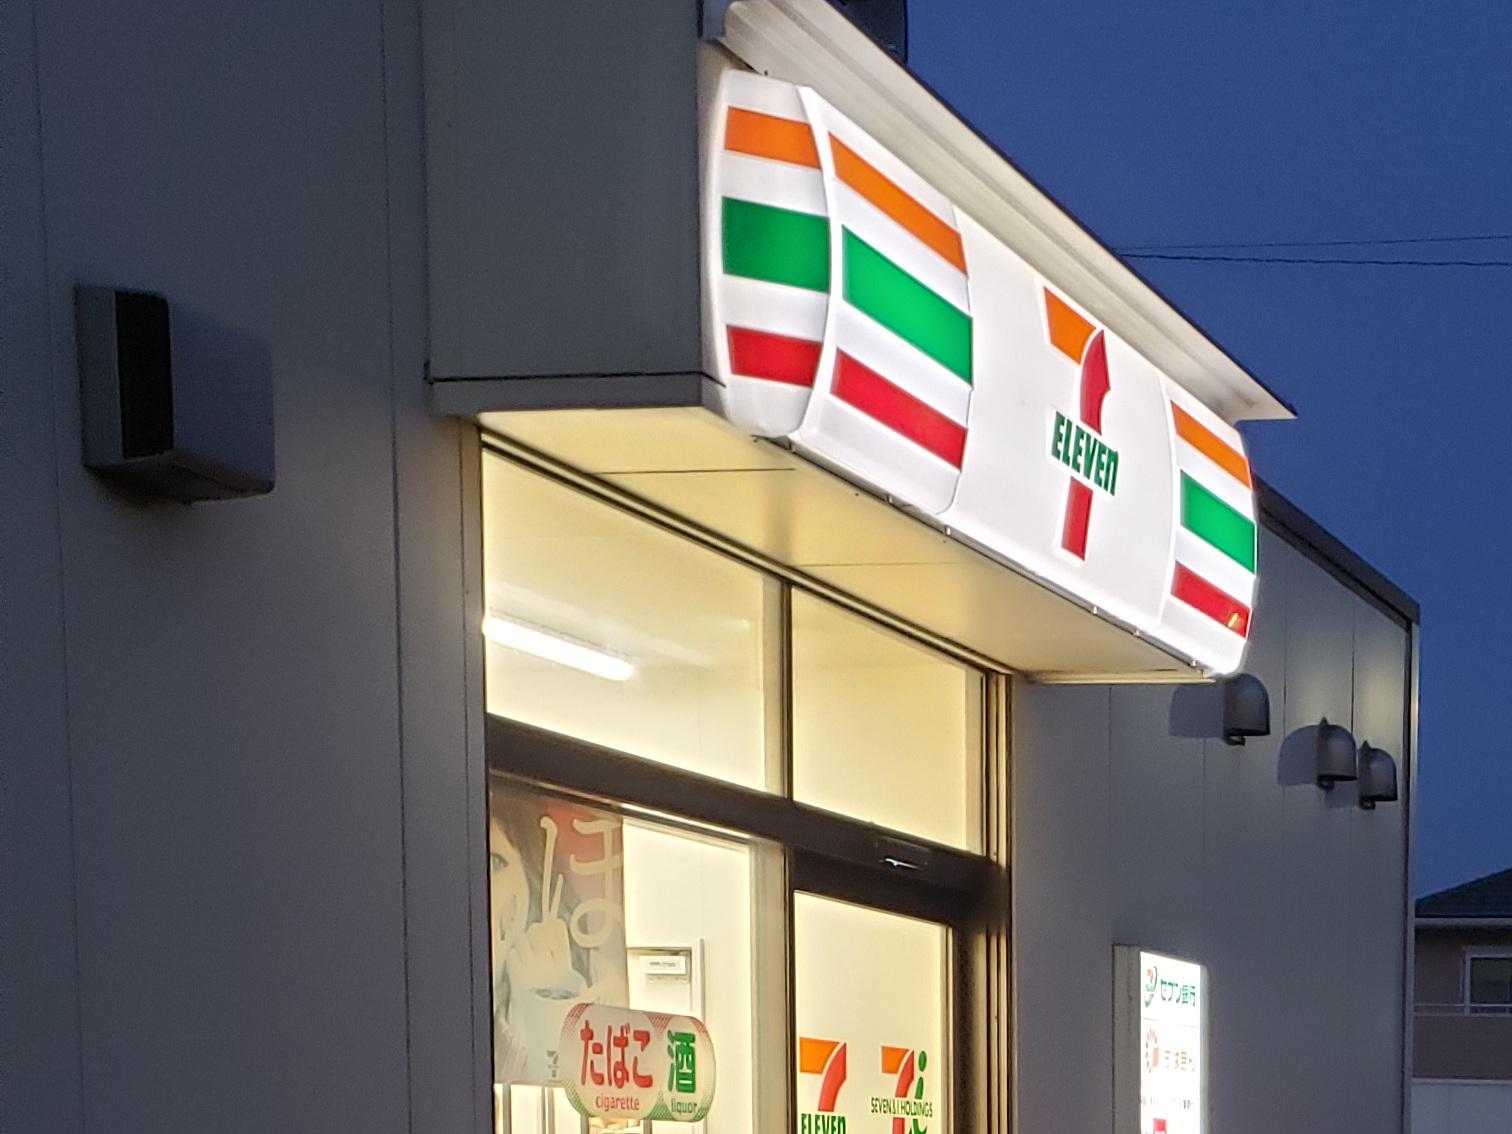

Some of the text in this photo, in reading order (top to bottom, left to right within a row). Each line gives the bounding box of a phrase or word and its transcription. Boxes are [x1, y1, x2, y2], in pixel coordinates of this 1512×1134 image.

[580, 1019, 653, 1089] たばこ
[667, 1029, 696, 1093] 酒
[595, 1095, 640, 1112] cigarette
[671, 1097, 698, 1116] liquor
